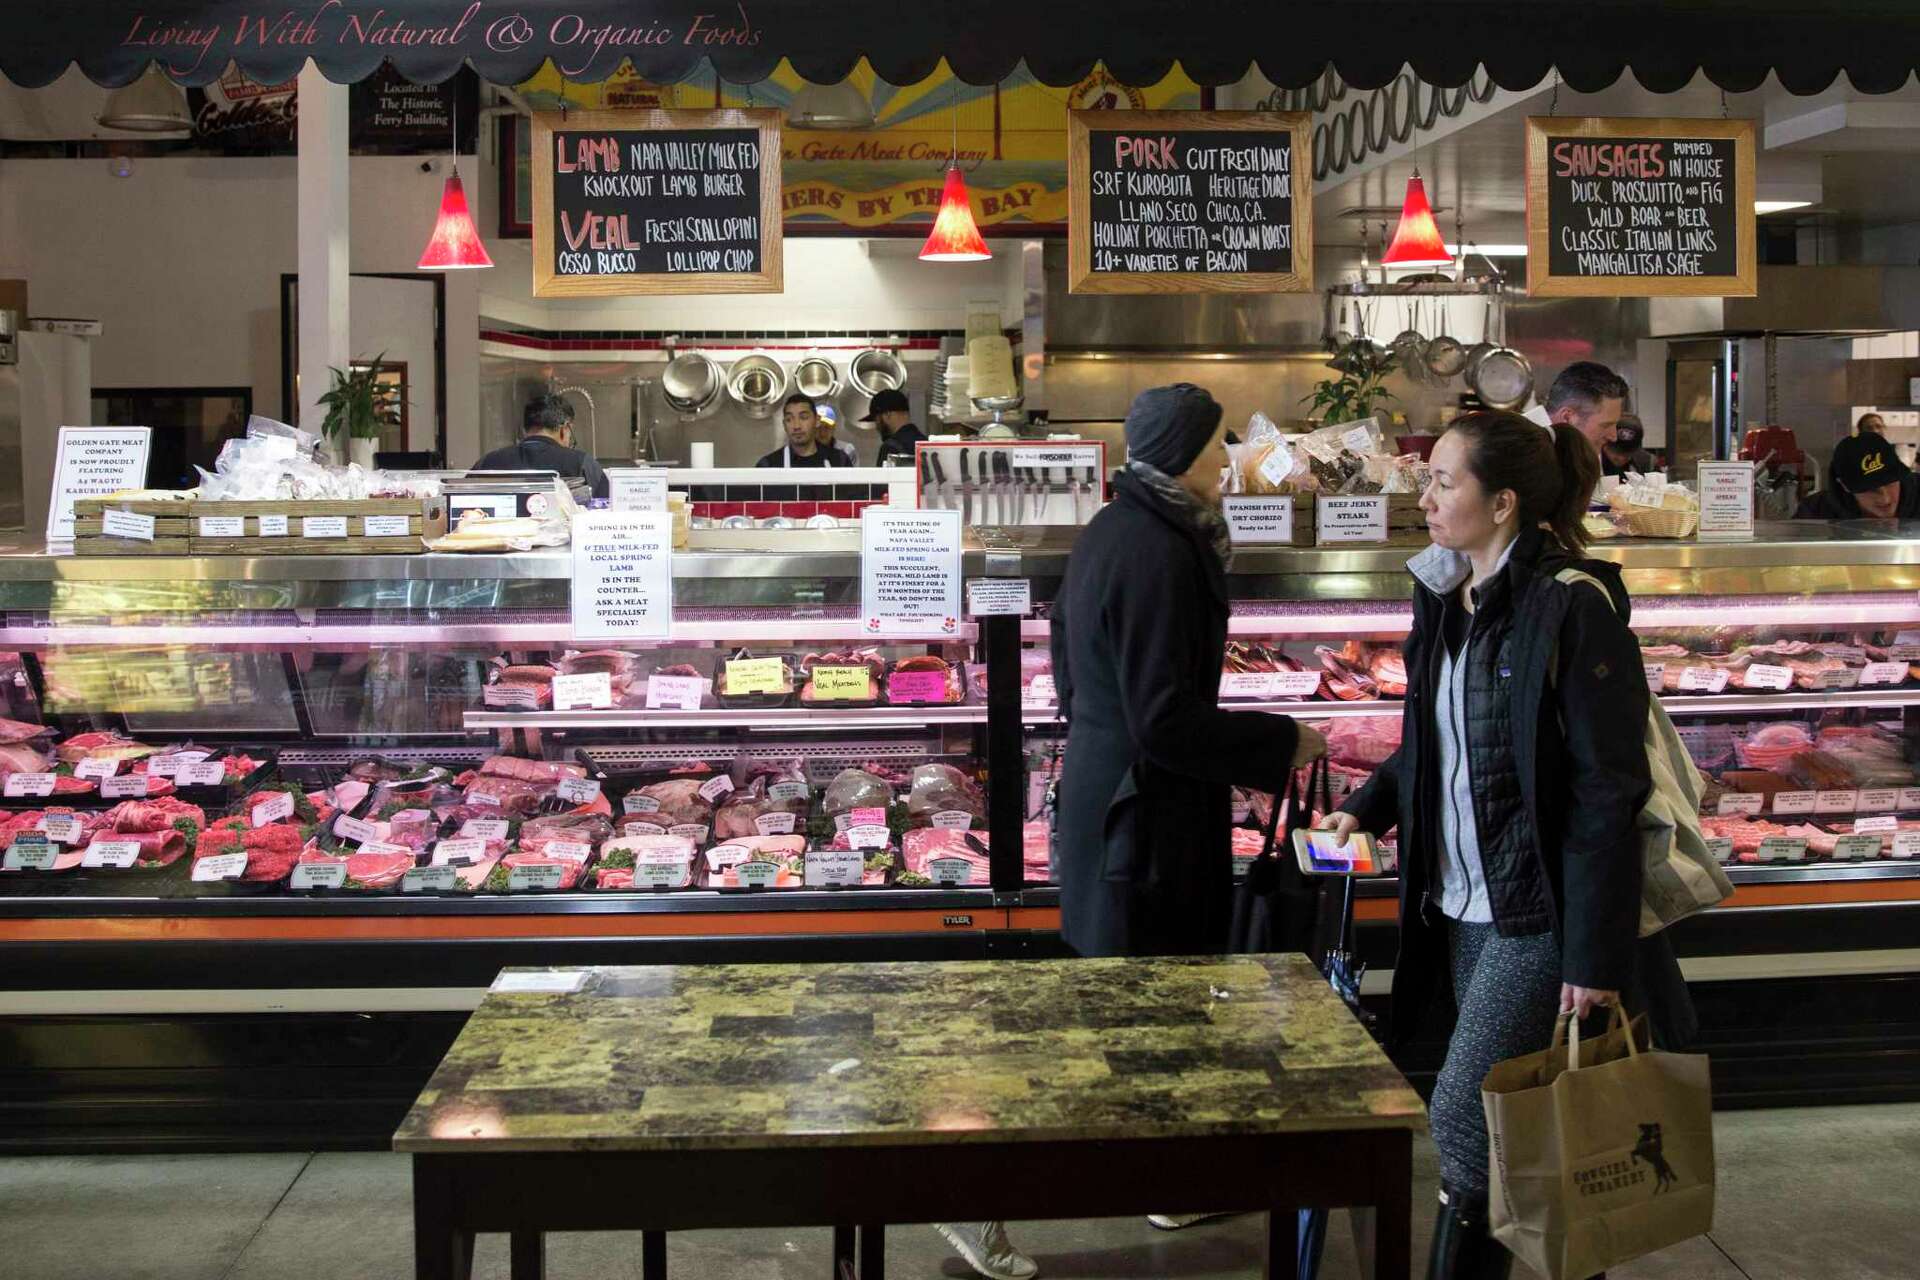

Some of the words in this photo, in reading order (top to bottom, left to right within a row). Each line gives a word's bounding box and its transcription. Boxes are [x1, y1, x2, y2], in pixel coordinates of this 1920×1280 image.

[121, 14, 219, 76] Living
[233, 1, 343, 46] With
[339, 2, 482, 45] Natural
[550, 15, 673, 75] Organic
[683, 2, 763, 46] Foods
[380, 98, 399, 109] The
[402, 97, 442, 109] Historic
[375, 113, 402, 128] Ferry
[405, 113, 448, 127] Building
[557, 136, 620, 173] LAMB
[631, 142, 663, 171] NAPA
[665, 142, 707, 171] VALLEY
[708, 143, 737, 170] MILK
[738, 142, 759, 170] FED
[801, 140, 846, 161] Gate
[850, 140, 905, 160] Meat
[908, 142, 987, 172] Company
[1115, 136, 1179, 170] PORK
[1186, 148, 1217, 170] CUT
[1220, 148, 1259, 172] FRESH
[1261, 147, 1290, 172] DAILY
[1554, 143, 1665, 178] SAUSAGES
[1673, 143, 1712, 156] PUMPED
[1669, 159, 1682, 177] IN
[1686, 158, 1724, 178] HOUSE
[584, 174, 654, 197] KNOCKOUT
[662, 174, 697, 197] LAMB
[704, 174, 746, 197] BURGER
[1093, 170, 1124, 195] SRF
[1128, 171, 1193, 197] KUROBUTA
[1209, 175, 1262, 199] HERITAGE
[1701, 182, 1722, 204] FIG
[857, 196, 894, 218] BY
[981, 187, 1037, 217] BAY
[1119, 200, 1164, 223] LLANO
[1166, 201, 1197, 223] SECO
[1587, 207, 1624, 227] WILD
[1631, 207, 1662, 227] BOAR
[1677, 207, 1709, 227] BEER
[560, 209, 640, 251] VEAL
[645, 218, 684, 244] FRESH
[686, 217, 758, 242] SCALLOPINI
[1094, 221, 1140, 248] HOLIDAY
[1145, 225, 1208, 250] PORCHETTA
[1222, 225, 1259, 250] CROWN
[1263, 224, 1290, 250] ROAST
[1562, 227, 1620, 252] CLASSIC
[1625, 229, 1673, 251] ITALIAN
[1677, 228, 1717, 252] LINKS
[559, 251, 591, 275] OSSO
[598, 252, 636, 274] BUCCO
[667, 251, 720, 272] LOLLIPOP
[724, 249, 754, 272] CHOP
[1095, 251, 1122, 271] 10+
[1125, 254, 1178, 272] VARIETIES
[1186, 256, 1199, 271] OF
[1206, 251, 1247, 272] BACON
[1578, 253, 1663, 276] MANGALITSA
[1666, 253, 1704, 275] SAGE
[1860, 452, 1885, 471] Cal
[610, 564, 634, 572] LAMB
[597, 609, 647, 617] SPECIALIST
[624, 598, 648, 606] MEAT
[944, 915, 971, 924] TYLER
